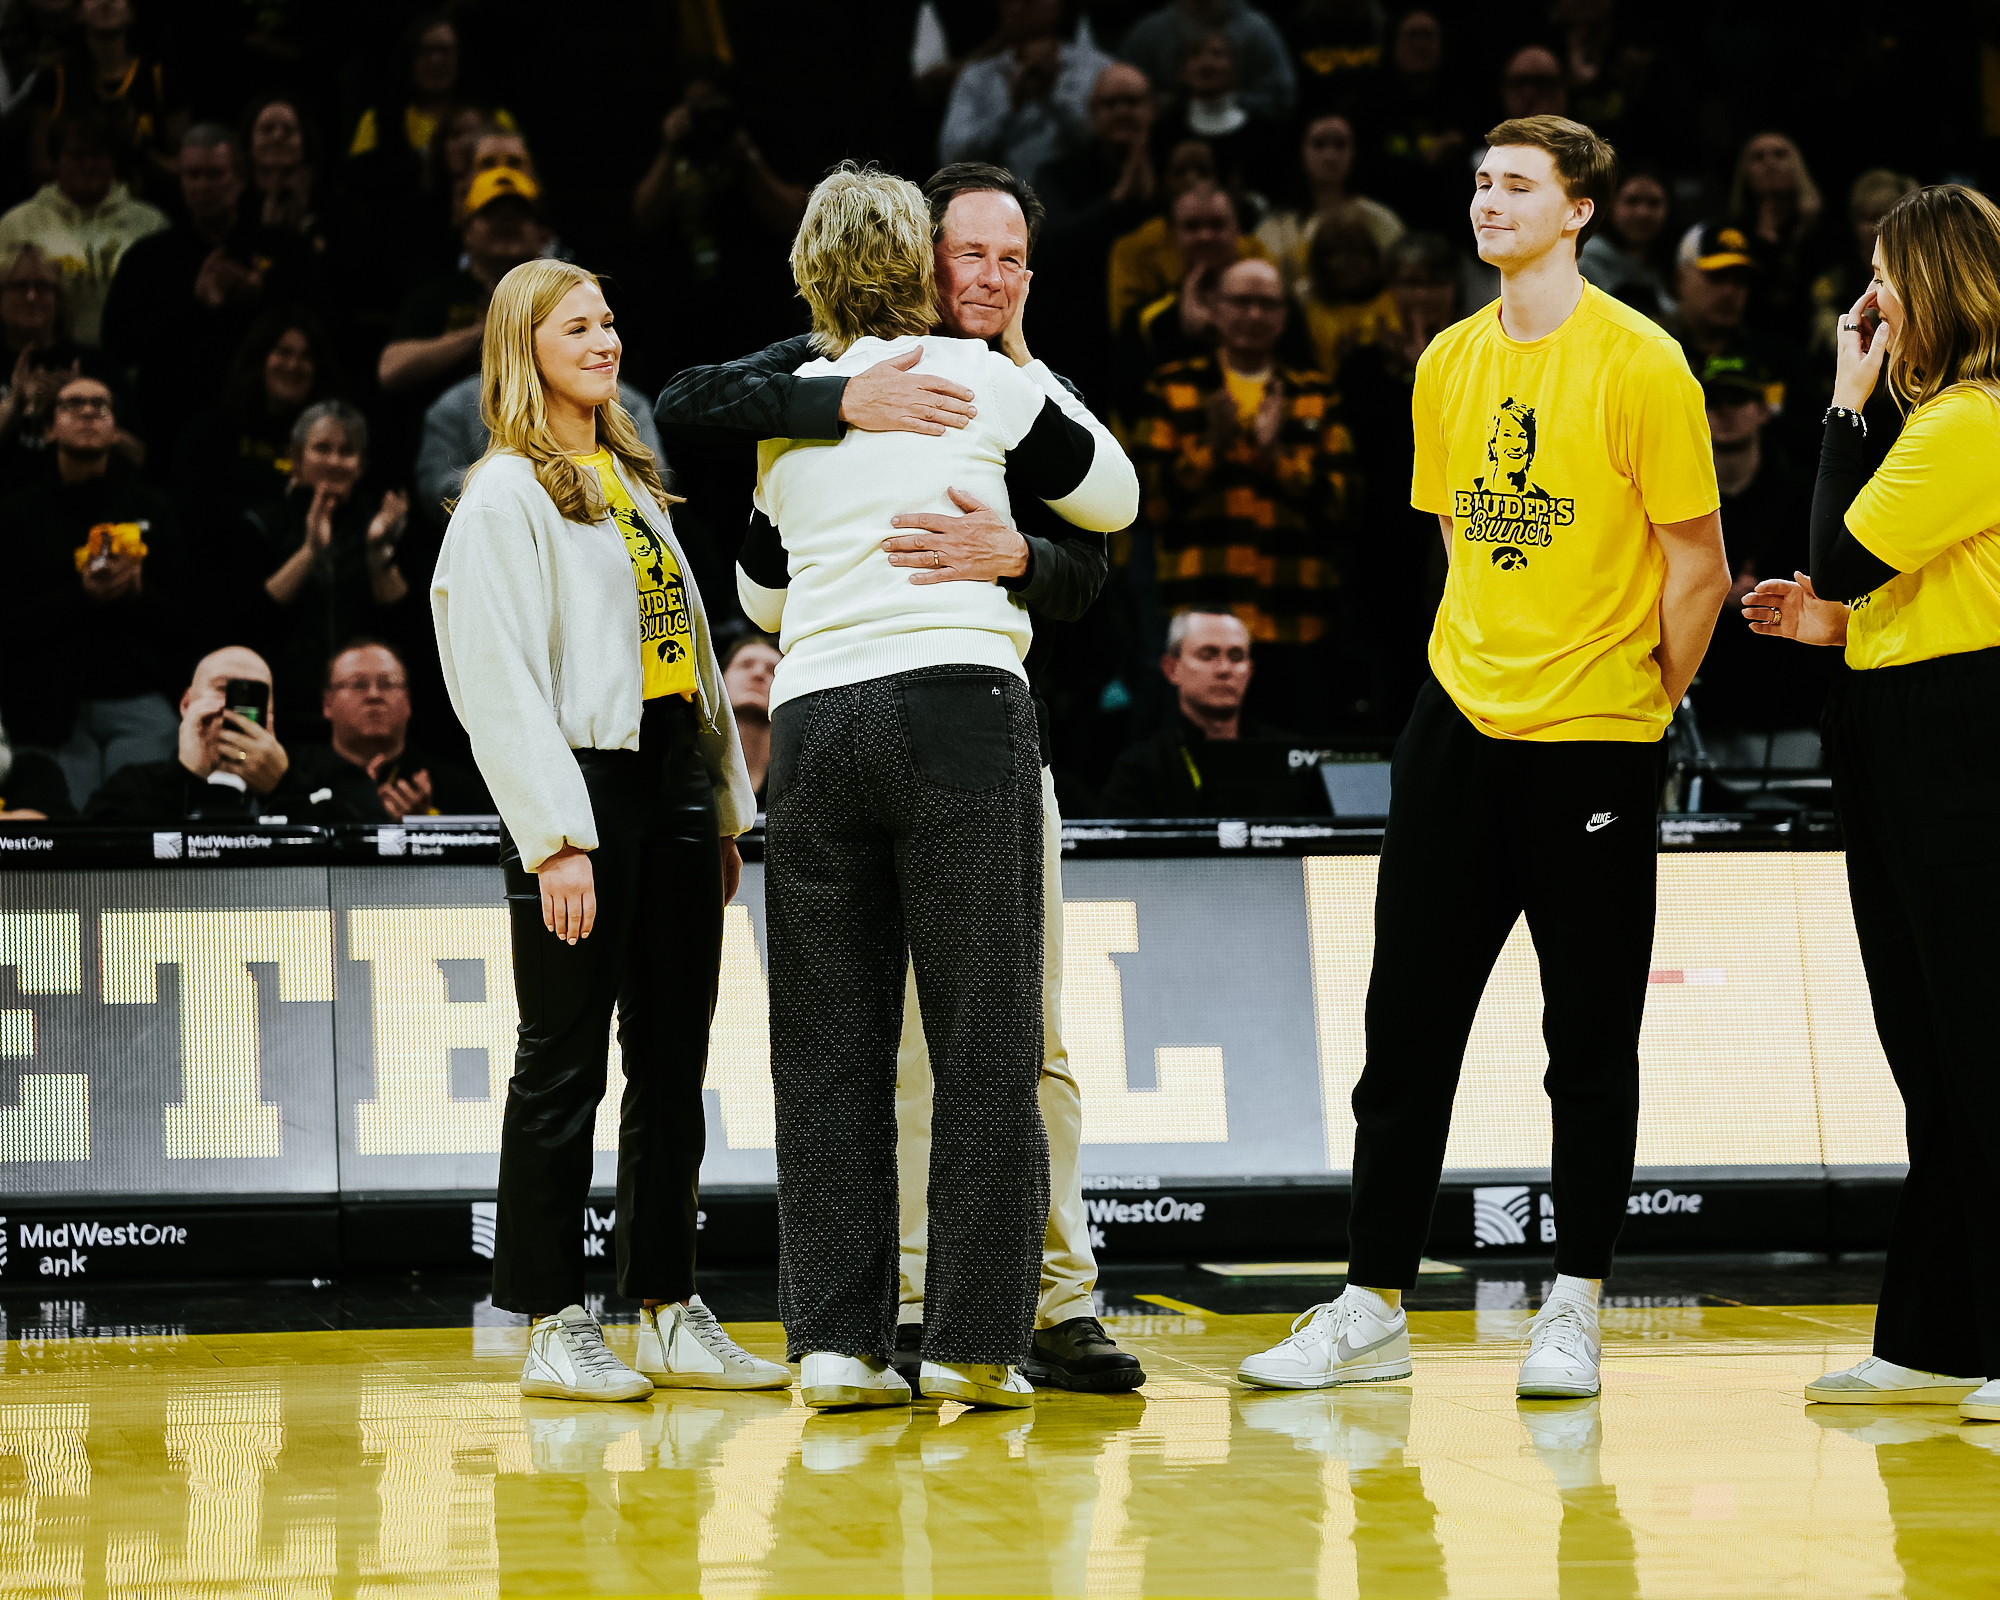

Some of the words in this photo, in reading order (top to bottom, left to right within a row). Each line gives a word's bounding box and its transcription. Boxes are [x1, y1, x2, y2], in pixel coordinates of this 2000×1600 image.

[1465, 508, 1552, 547] Bunch
[1590, 811, 1612, 824] NIKE
[1084, 1196, 1206, 1223] WestOne
[19, 1221, 188, 1249] MidWestOne
[38, 1248, 89, 1278] ank
